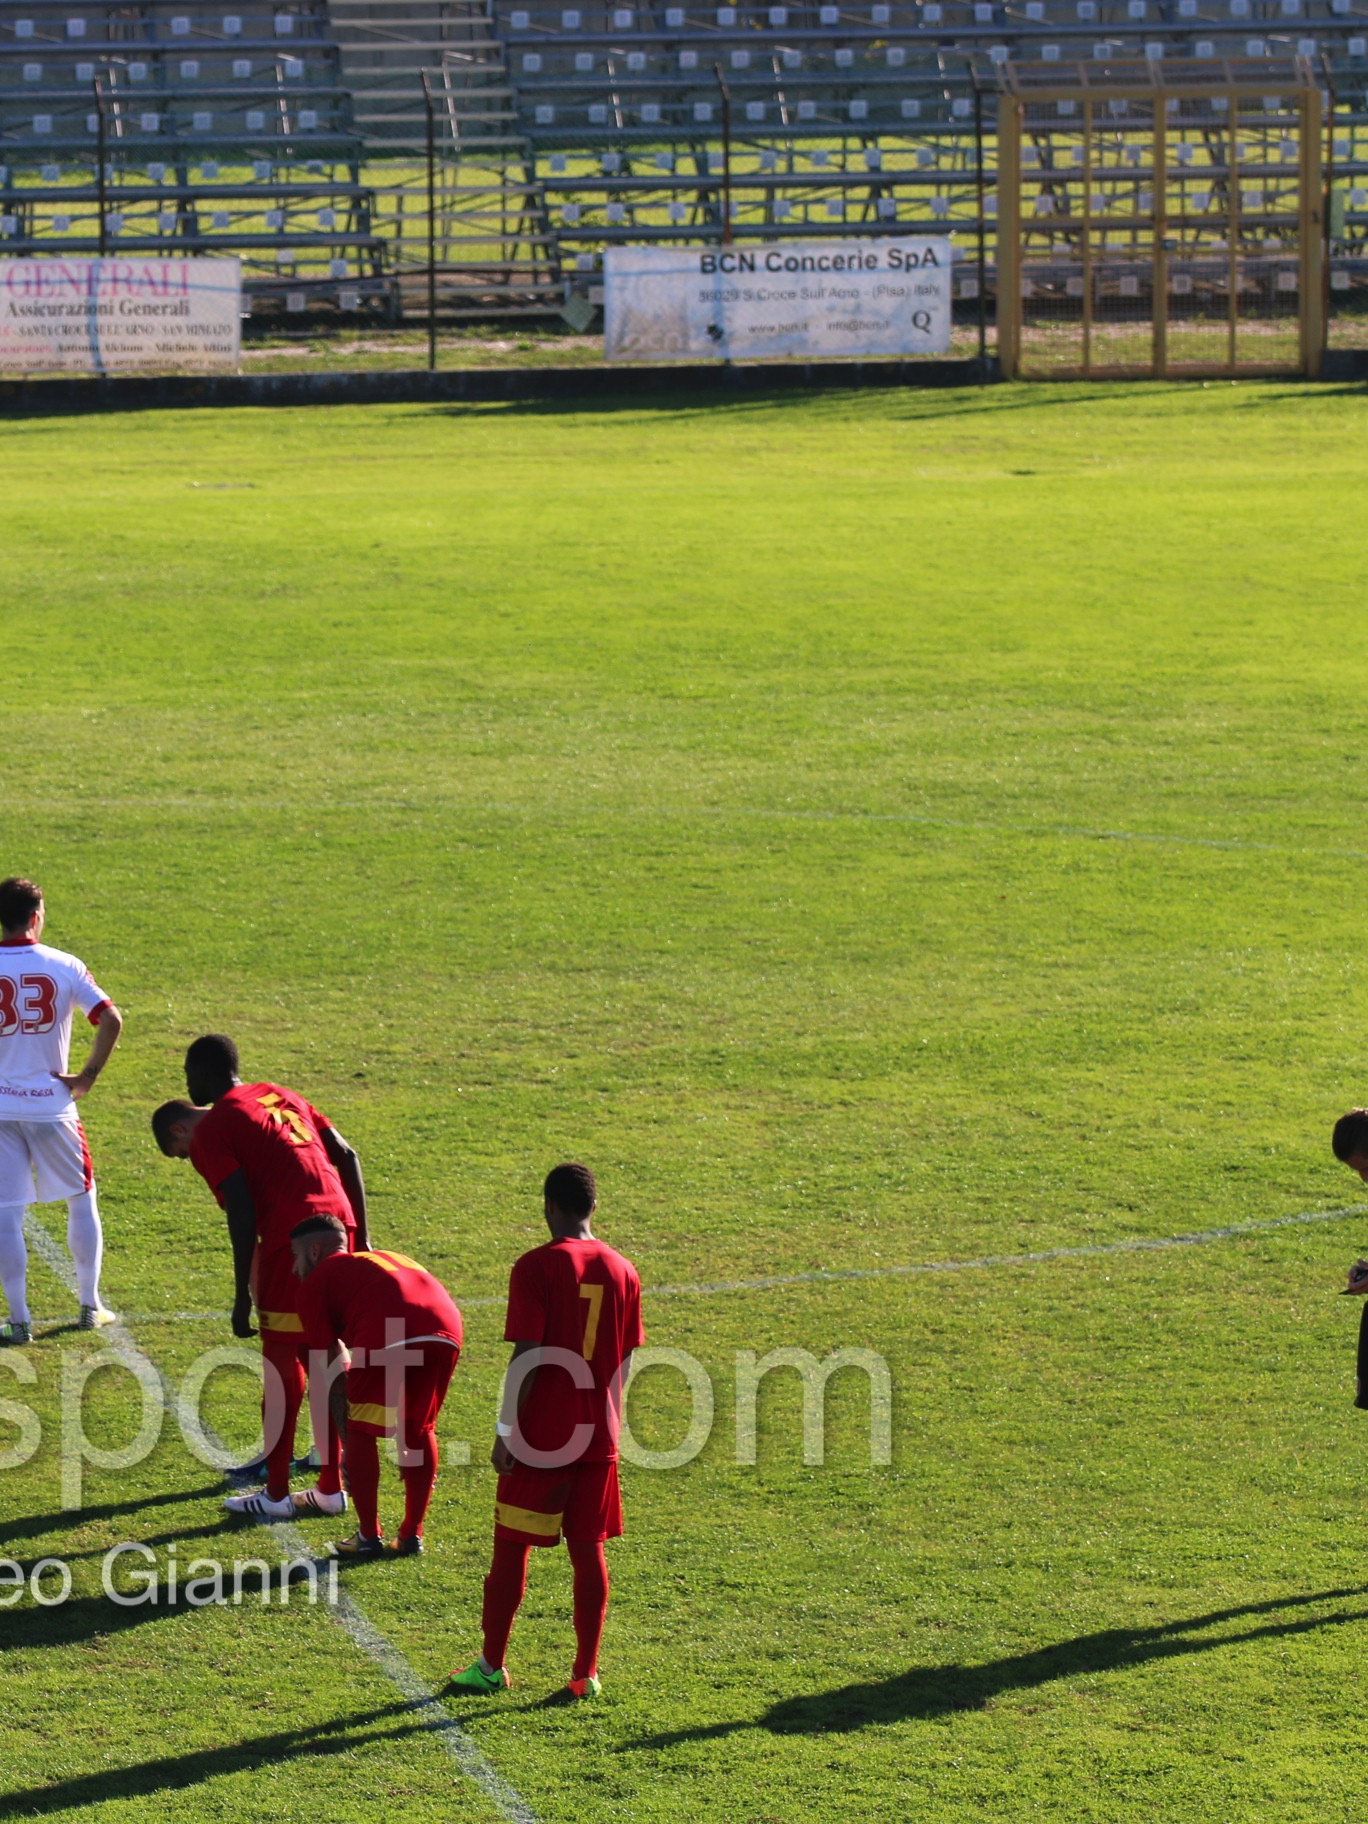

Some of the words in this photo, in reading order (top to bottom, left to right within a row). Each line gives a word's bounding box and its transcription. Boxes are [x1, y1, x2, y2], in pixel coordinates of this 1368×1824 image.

[699, 253, 756, 275] BCN
[764, 250, 879, 273] Concerie
[887, 247, 940, 273] SpA
[5, 262, 191, 298] GENERALI
[6, 301, 114, 318] Assicurazioni
[119, 299, 191, 316] Generali
[578, 1282, 605, 1361] 7
